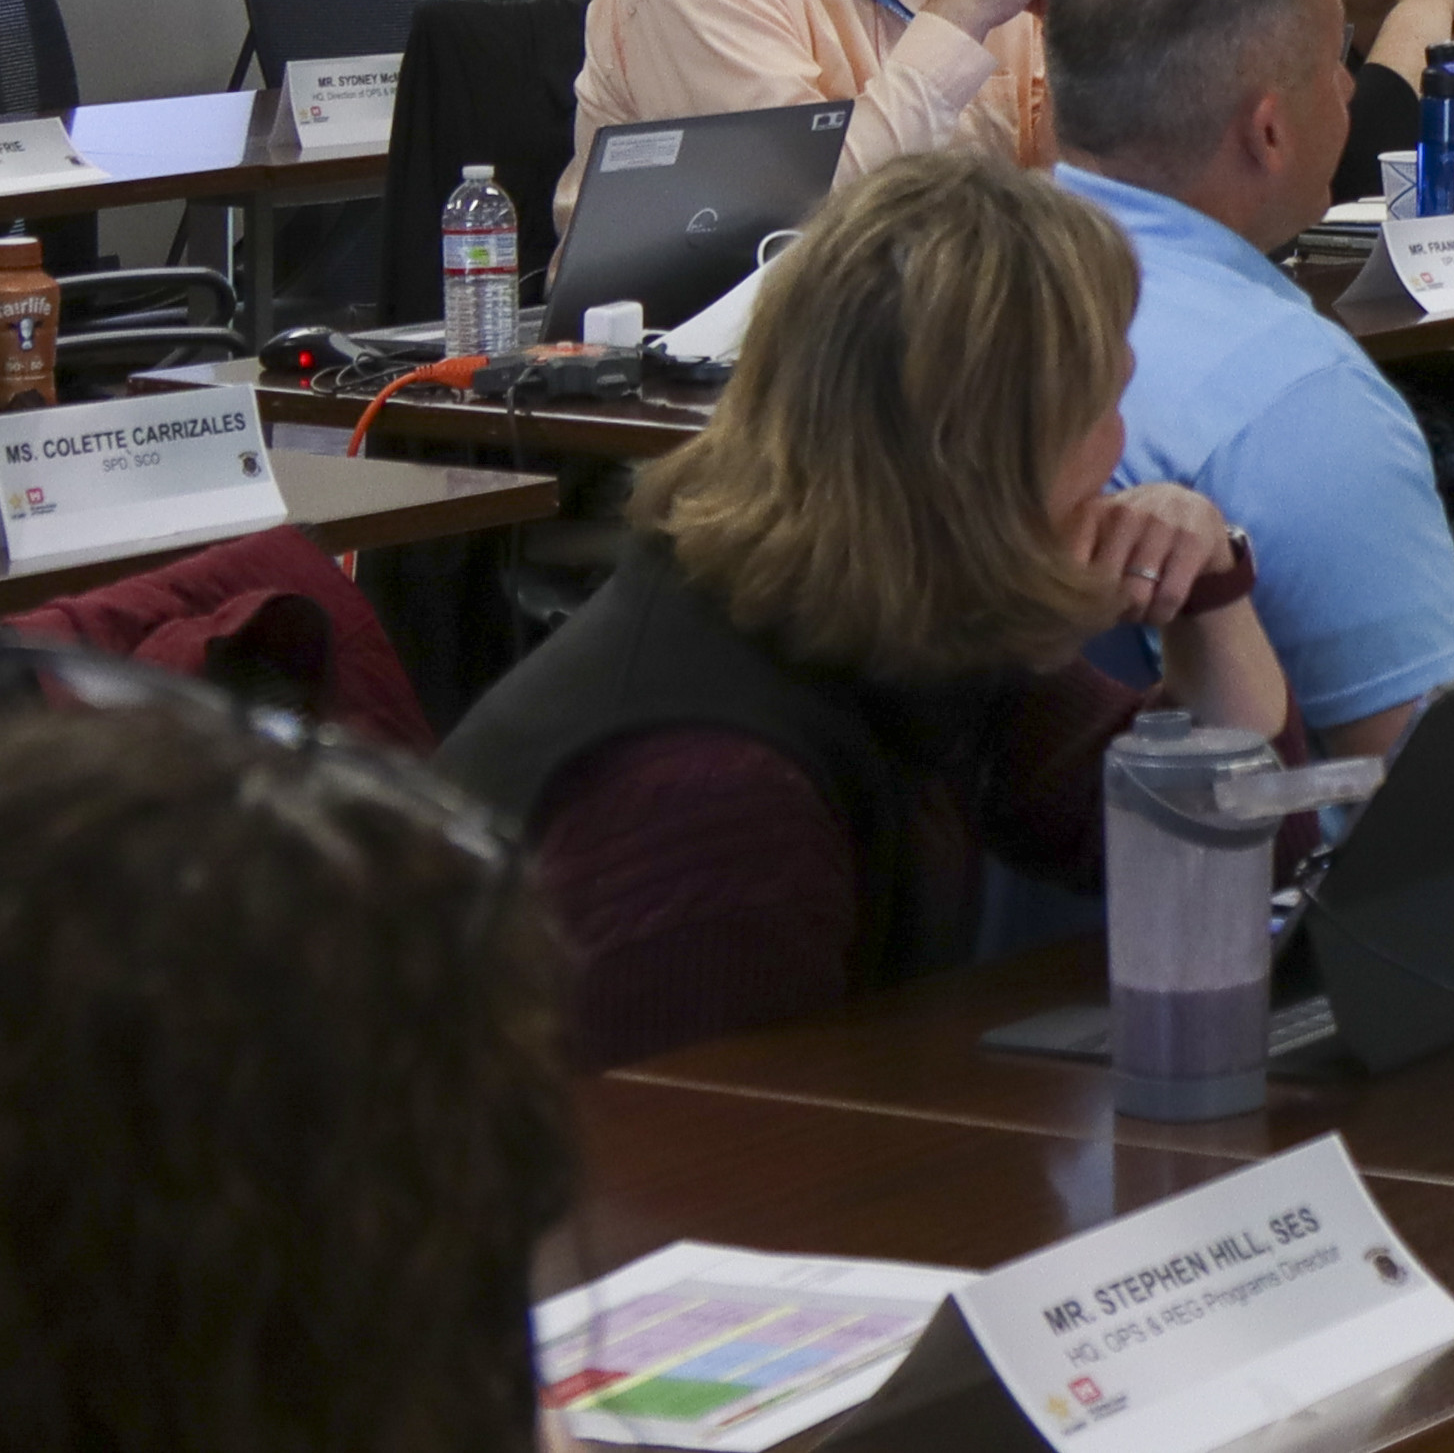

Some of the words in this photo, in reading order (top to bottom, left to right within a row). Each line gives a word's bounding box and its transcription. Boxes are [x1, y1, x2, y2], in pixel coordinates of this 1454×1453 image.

[318, 76, 336, 88] MR.
[338, 73, 377, 87] SYDNEY
[1408, 241, 1425, 257] MR.
[6, 443, 38, 465] MS.
[43, 430, 128, 459] COLETTE
[132, 412, 246, 447] CARRIZALES
[1043, 1299, 1097, 1336] MR.
[1093, 1249, 1212, 1316] STEPHEN
[1205, 1230, 1273, 1273] HILL,
[1269, 1206, 1322, 1246] SES
[1103, 1322, 1149, 1355] OPS
[1150, 1316, 1165, 1338] &
[1162, 1299, 1205, 1329] REG
[1205, 1268, 1282, 1310] Programs
[1277, 1243, 1343, 1282] Director
